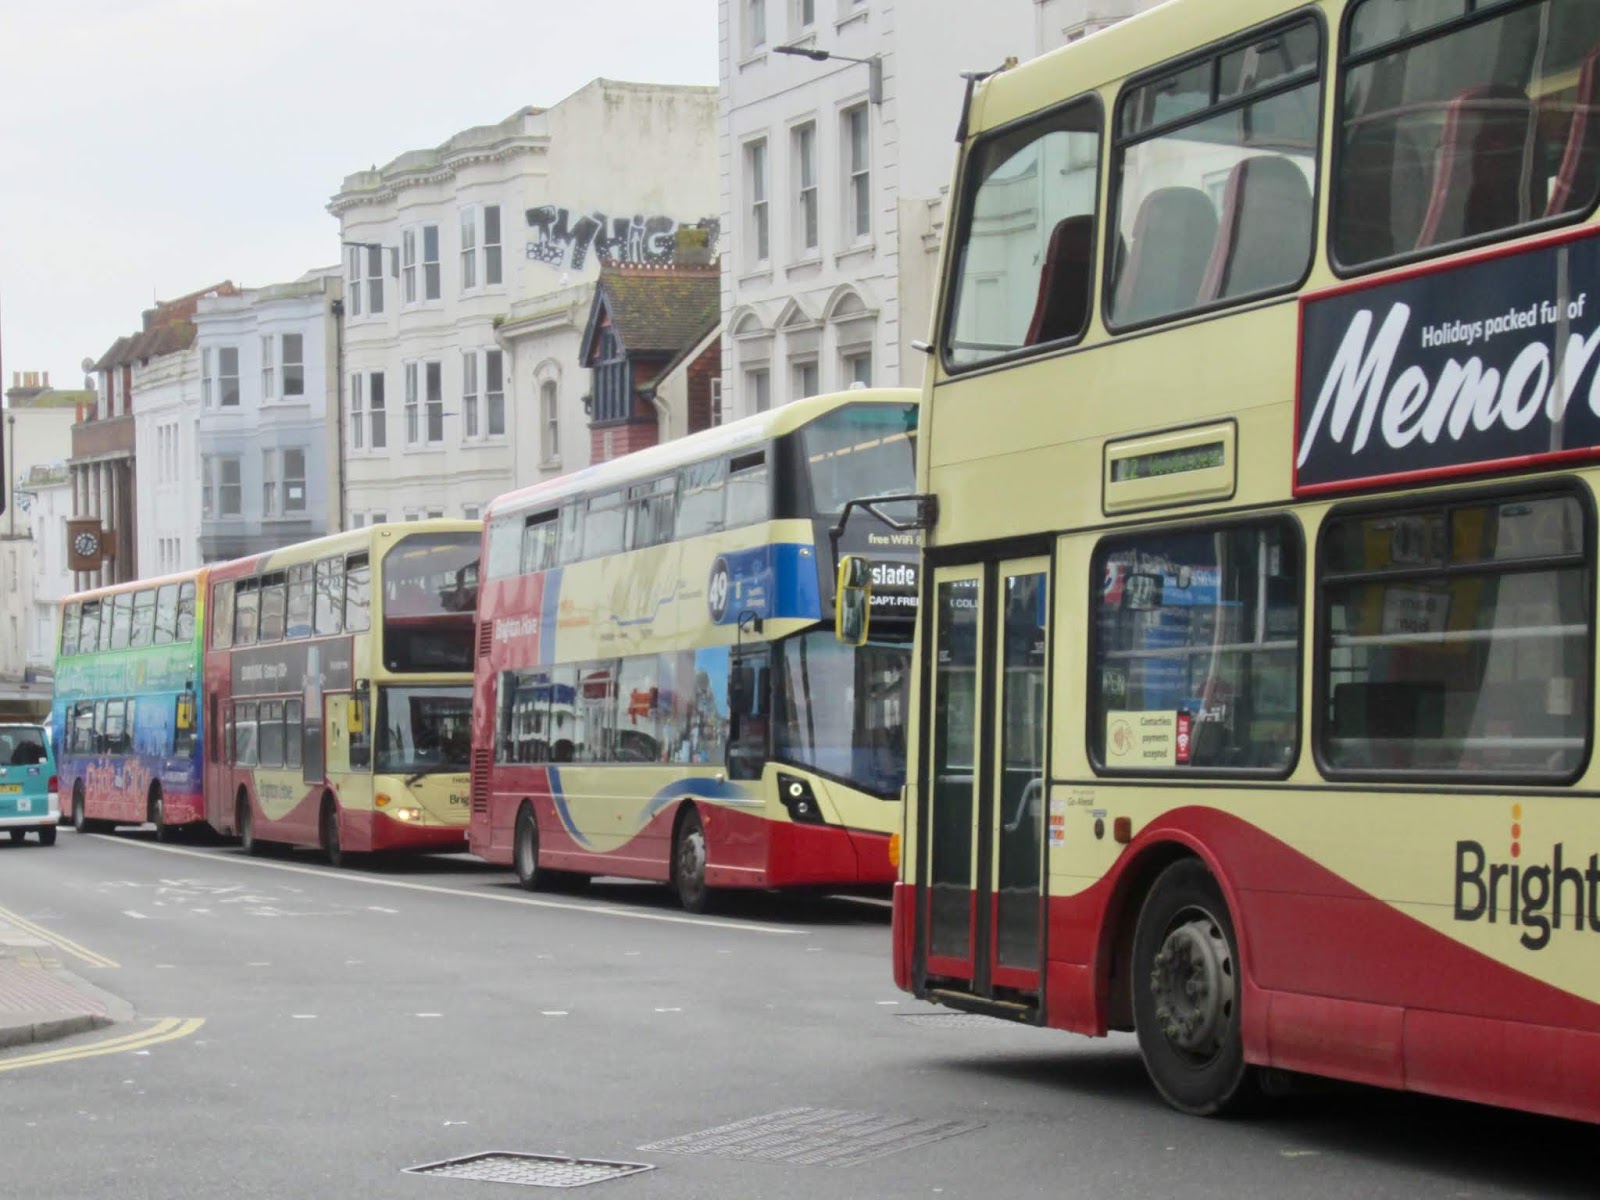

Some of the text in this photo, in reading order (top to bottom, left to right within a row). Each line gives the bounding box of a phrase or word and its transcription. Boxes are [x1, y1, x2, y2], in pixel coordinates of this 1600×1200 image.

[1421, 293, 1586, 348] Holidays packed ful of
[1297, 302, 1600, 469] Memor
[868, 533, 889, 544] free
[891, 534, 913, 545] WiFi
[870, 563, 915, 586] slade
[709, 571, 728, 610] 49
[1142, 734, 1169, 744] payments
